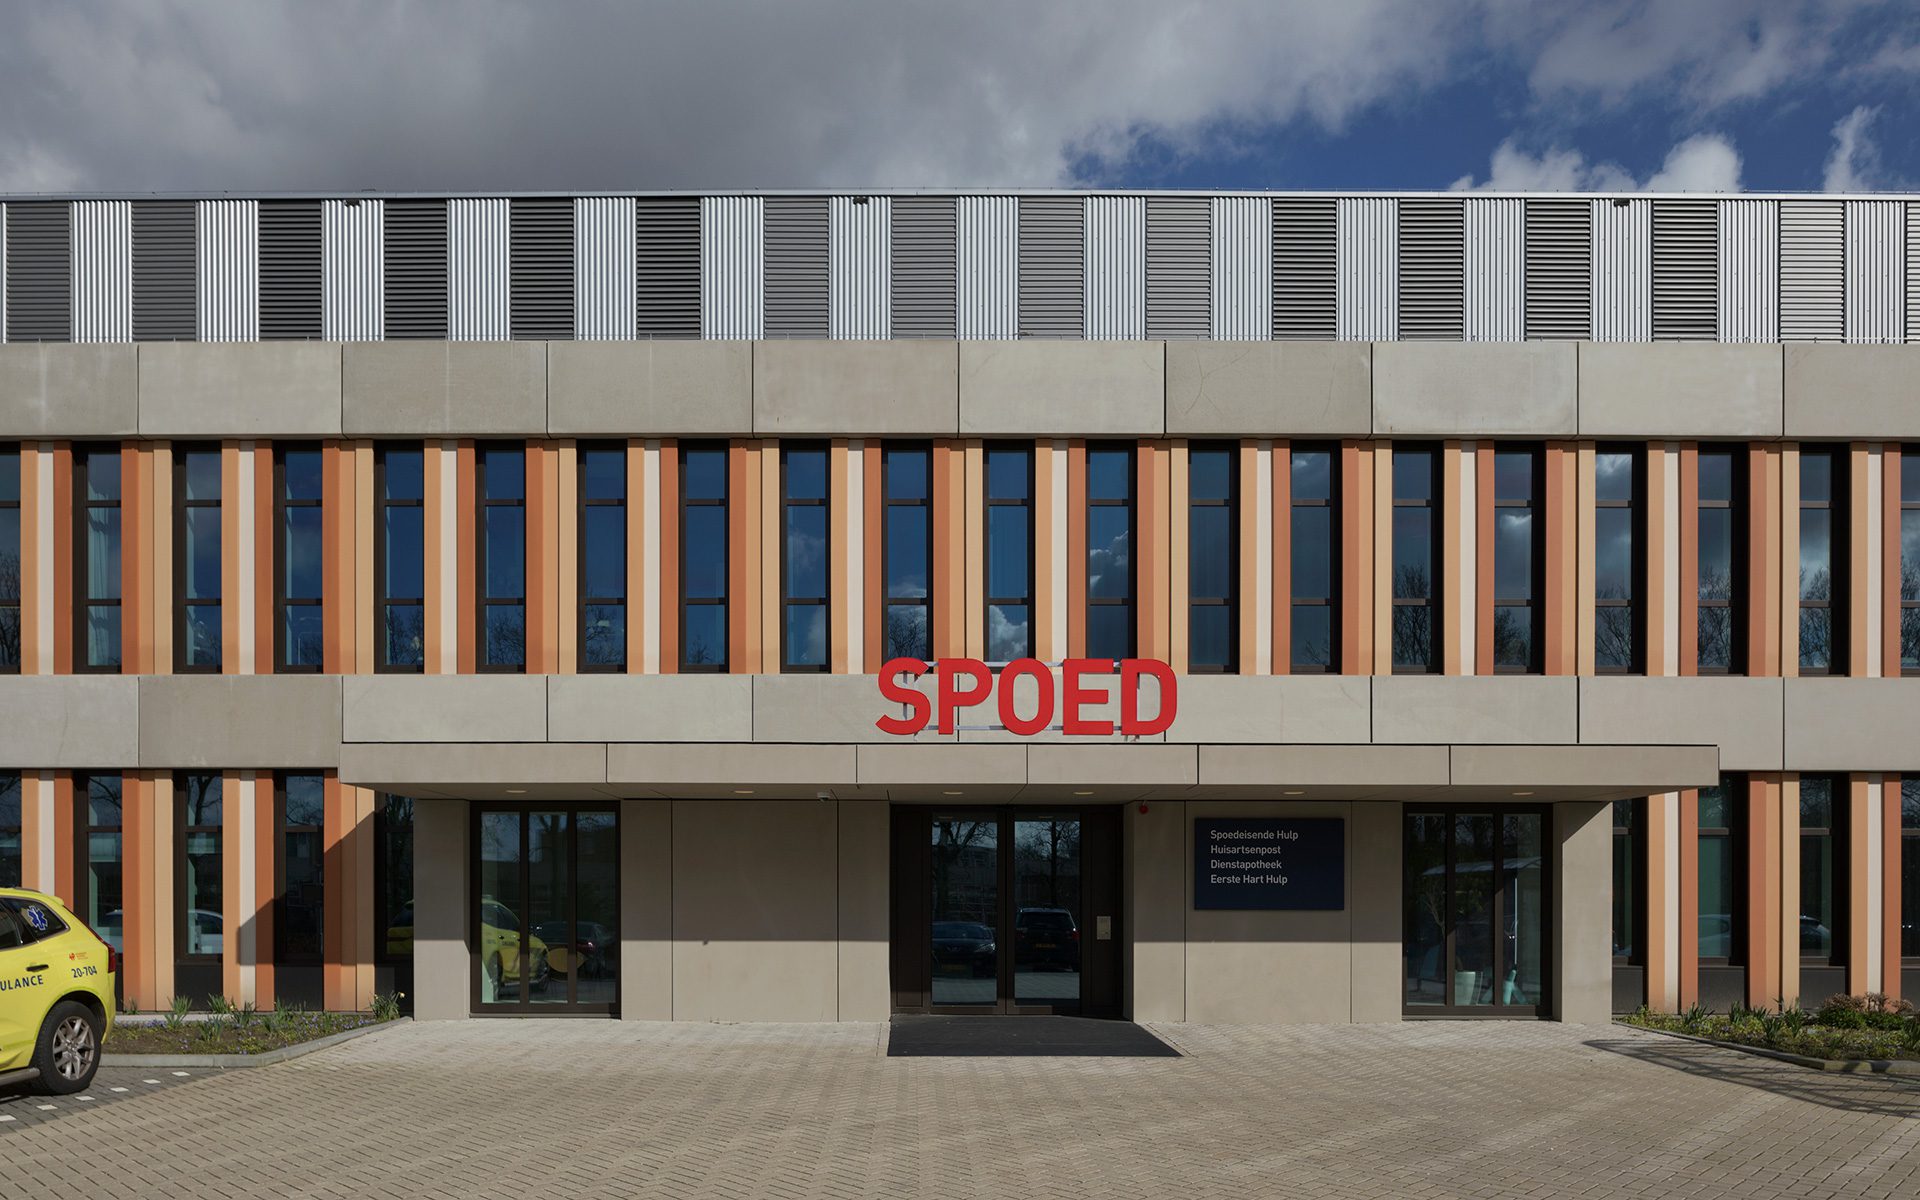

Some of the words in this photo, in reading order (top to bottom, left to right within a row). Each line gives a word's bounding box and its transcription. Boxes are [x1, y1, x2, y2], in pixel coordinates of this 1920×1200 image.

[875, 657, 1178, 736] SPOED
[1210, 829, 1275, 841] Spoedeisende
[1276, 830, 1299, 841] Hulp
[1210, 844, 1281, 856] Huisartsenpost
[1210, 859, 1282, 871] Dienstapotheek
[1210, 874, 1241, 884] Eerste
[1242, 874, 1264, 884] Hart
[1265, 874, 1288, 886] Hulp
[71, 965, 98, 979] 20-704
[0, 974, 44, 991] ULANCE
